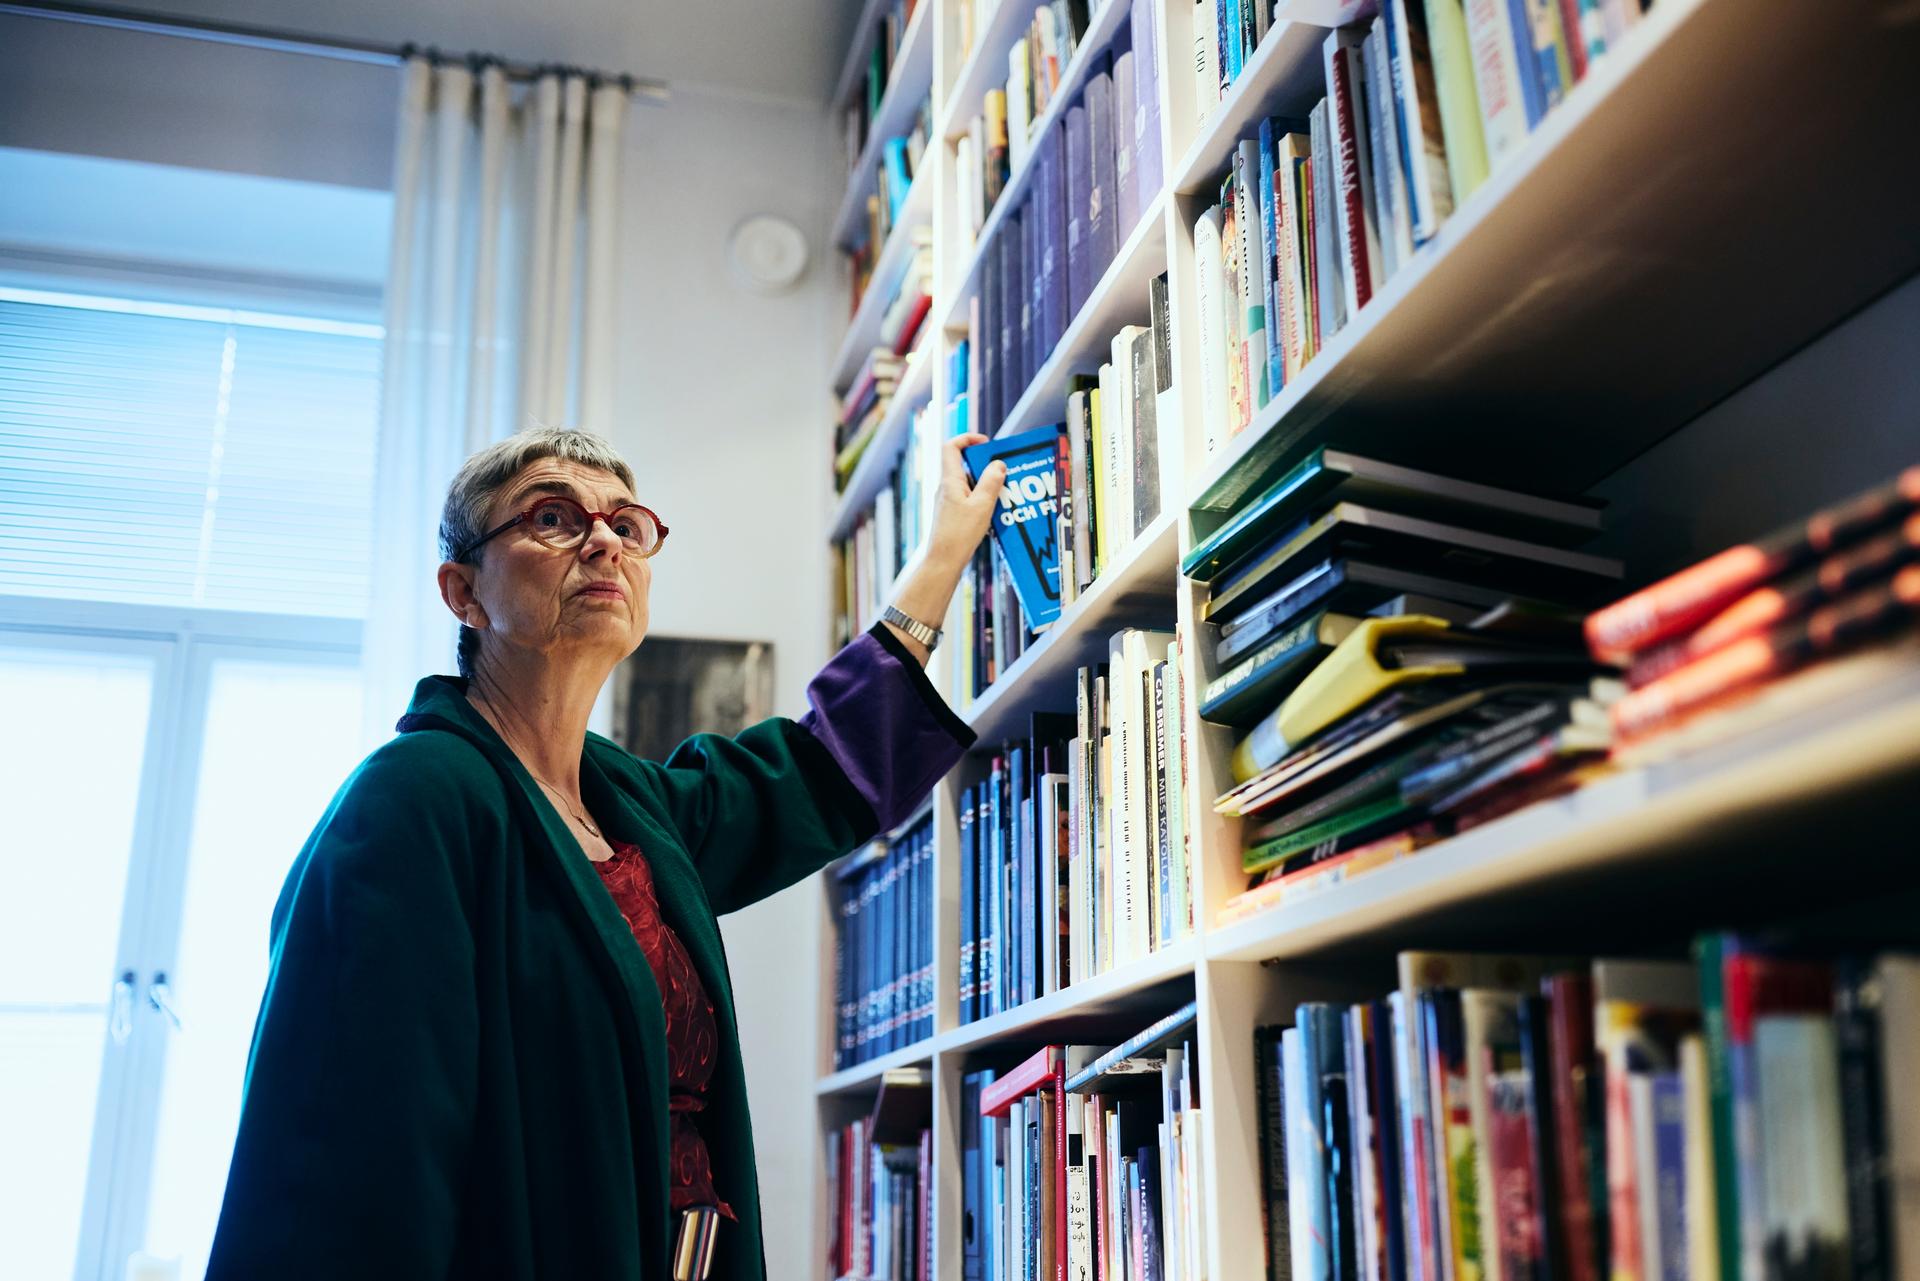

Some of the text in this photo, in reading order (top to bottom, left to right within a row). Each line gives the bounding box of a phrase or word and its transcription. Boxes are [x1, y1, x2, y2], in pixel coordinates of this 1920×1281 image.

[1000, 505, 1038, 526] OCH
[1155, 677, 1164, 705] CAJ
[1156, 708, 1166, 772] BREMER
[1158, 777, 1168, 814] MIES
[1159, 816, 1170, 885] KATOLLA
